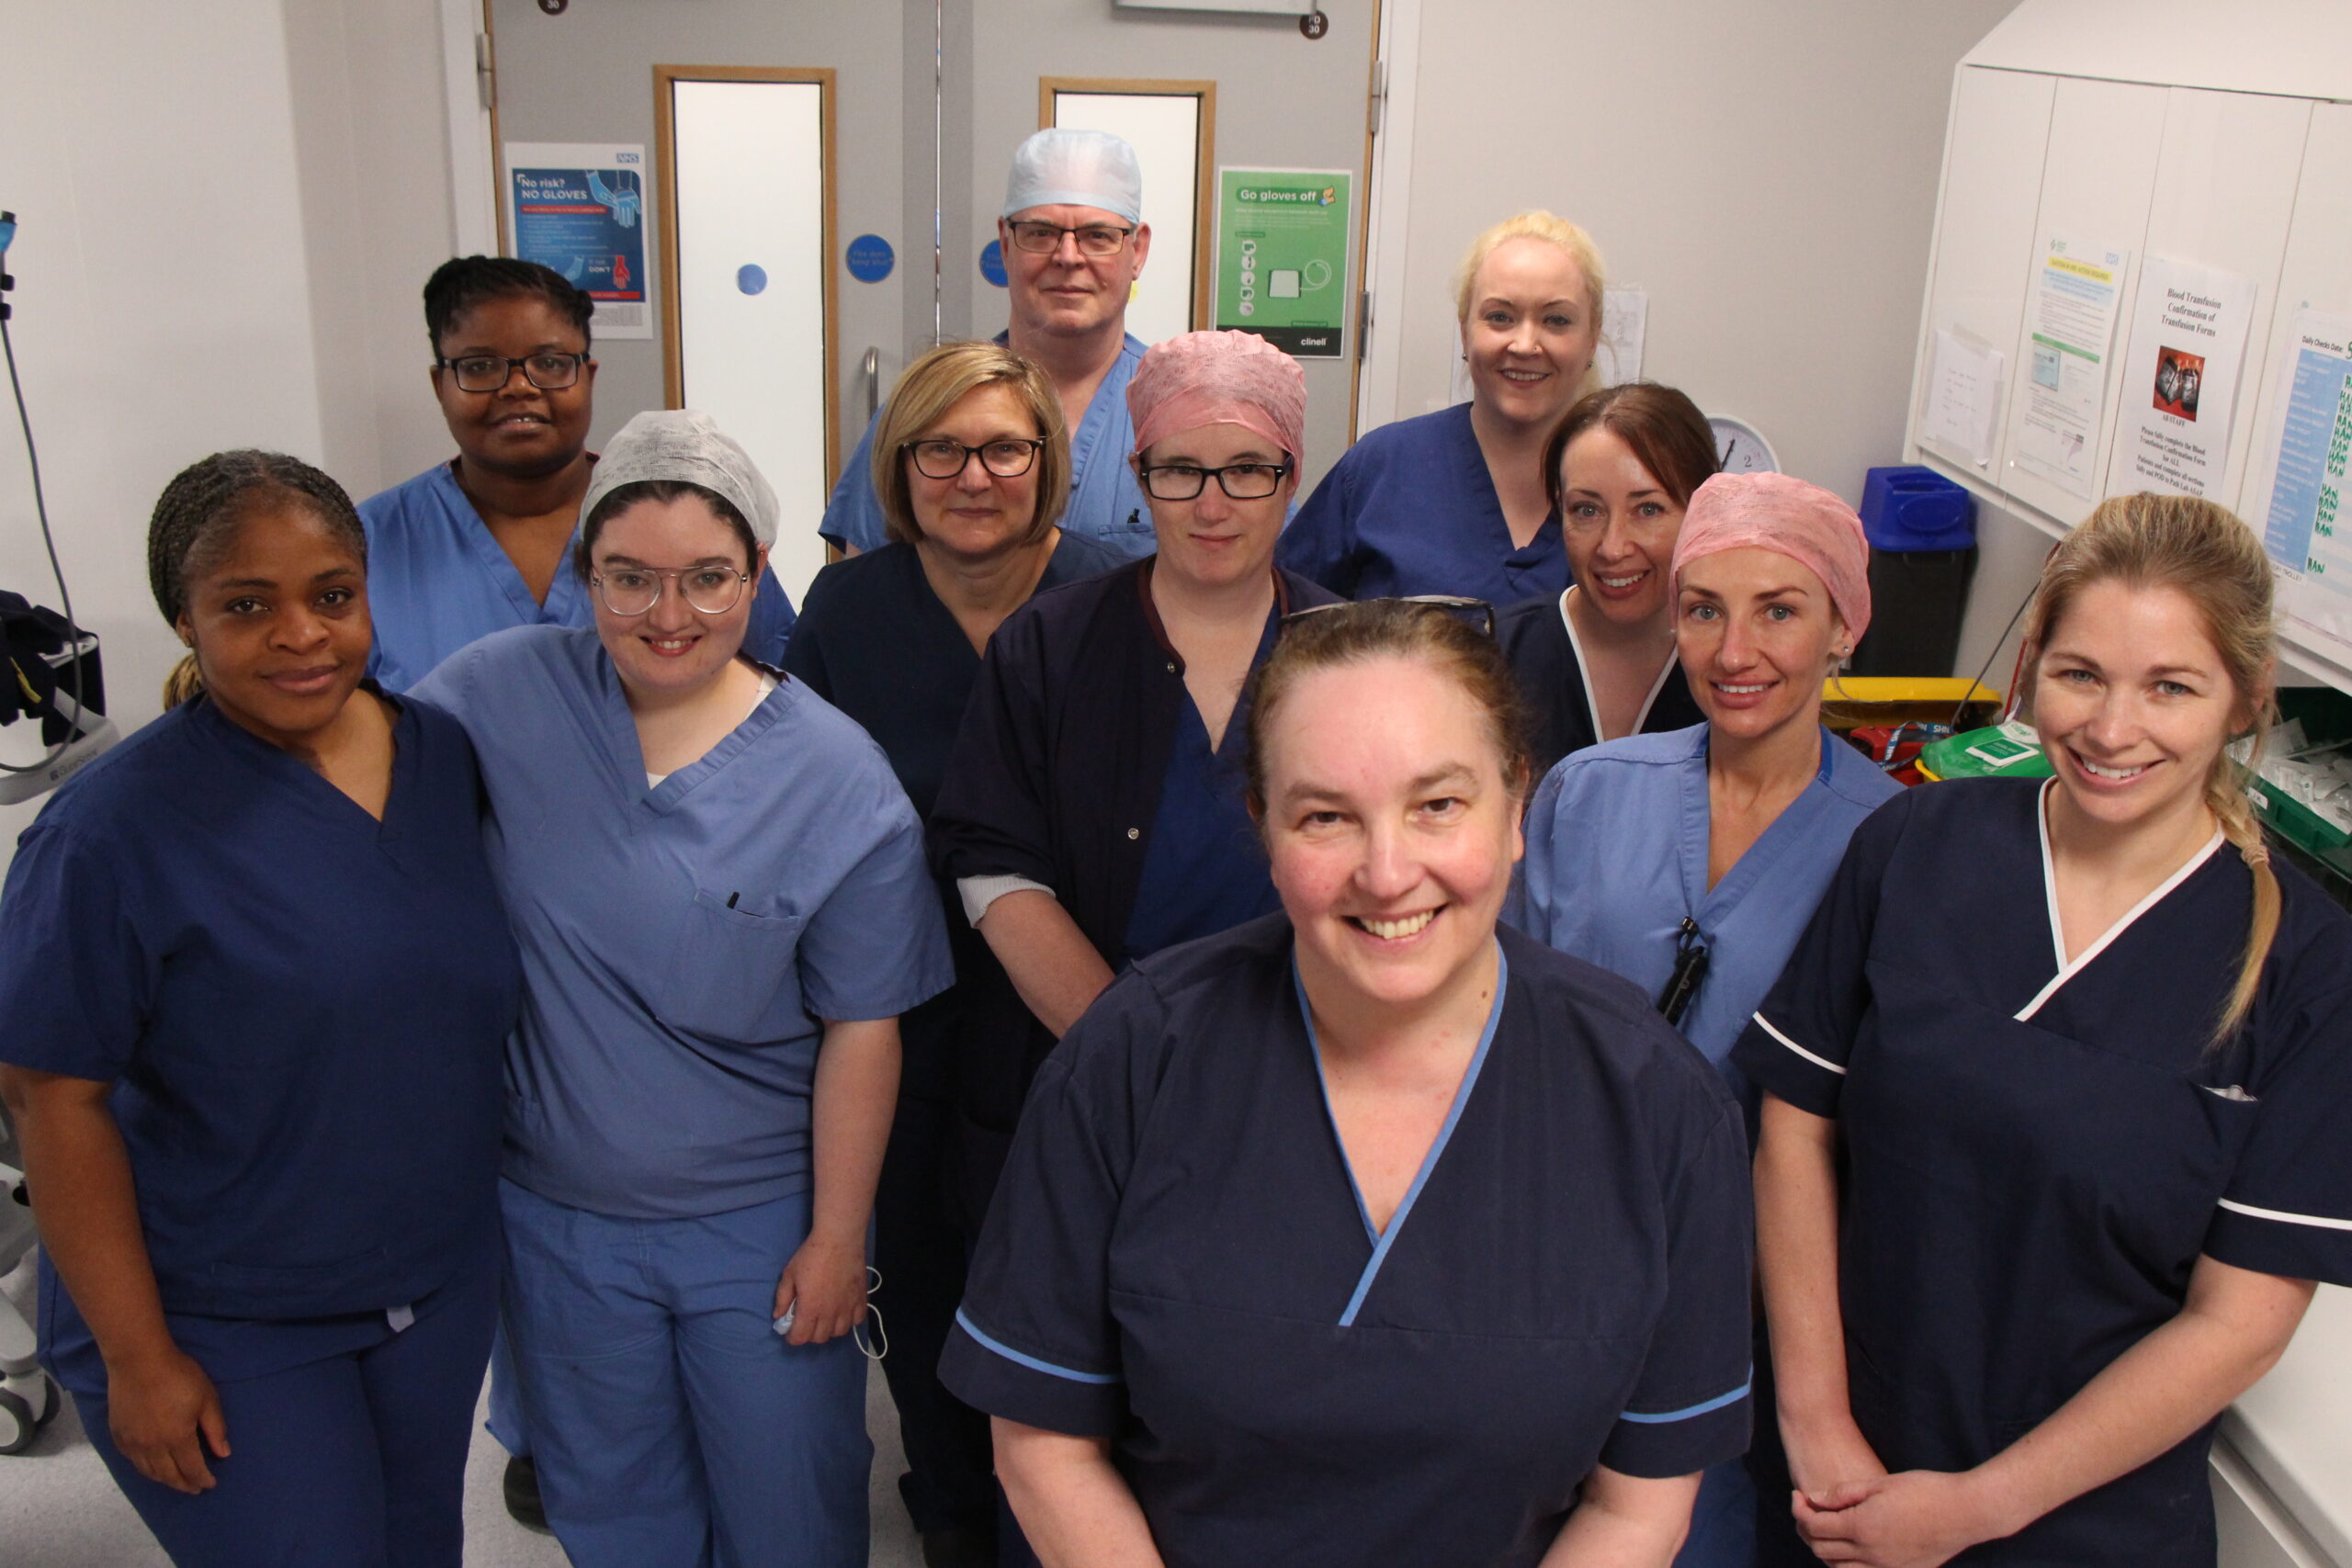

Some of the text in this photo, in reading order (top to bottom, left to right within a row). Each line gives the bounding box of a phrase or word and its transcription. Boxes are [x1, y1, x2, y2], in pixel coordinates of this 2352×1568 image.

[1308, 25, 1320, 34] 30
[616, 153, 639, 164] NHS
[522, 177, 566, 188] No risk?
[522, 189, 588, 200] NO GLOVES
[1240, 189, 1317, 202] Go gloves off
[2167, 288, 2222, 310] Blood Transfusion
[2168, 302, 2216, 322] Confirmation of
[2161, 314, 2216, 337] Transfusion Forms
[1300, 337, 1327, 346] clinell
[2301, 334, 2313, 346] Daily
[2314, 338, 2330, 350] Checks
[2142, 425, 2154, 436] Please
[2165, 435, 2184, 447] complete
[2192, 444, 2206, 456] Blood
[2164, 445, 2193, 462] Confirmation
[1744, 456, 1752, 468] 2
[2162, 466, 2181, 478] complete
[1933, 724, 1951, 734] NHS
